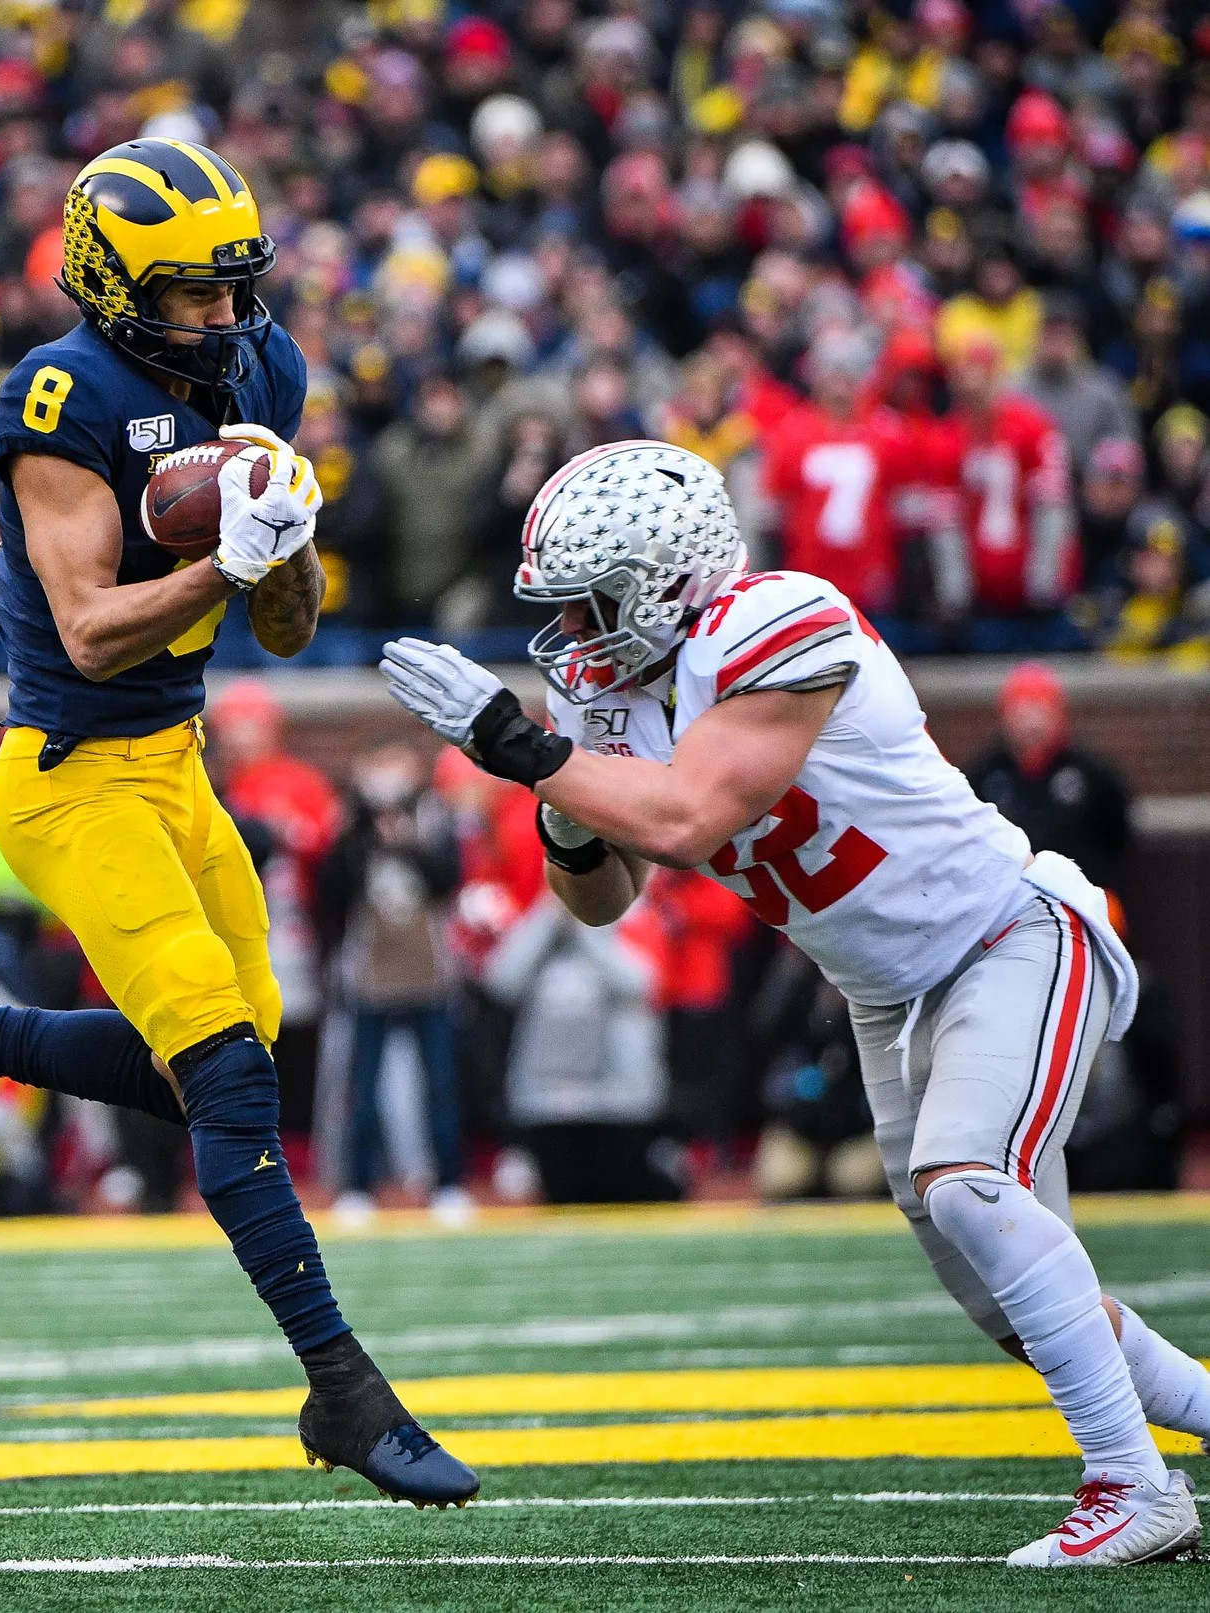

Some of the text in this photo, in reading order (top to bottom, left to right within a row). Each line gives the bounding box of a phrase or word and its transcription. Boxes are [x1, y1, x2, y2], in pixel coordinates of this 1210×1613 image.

[234, 241, 249, 257] M
[22, 365, 74, 435] 8
[127, 413, 175, 452] 150
[801, 442, 877, 548] 7
